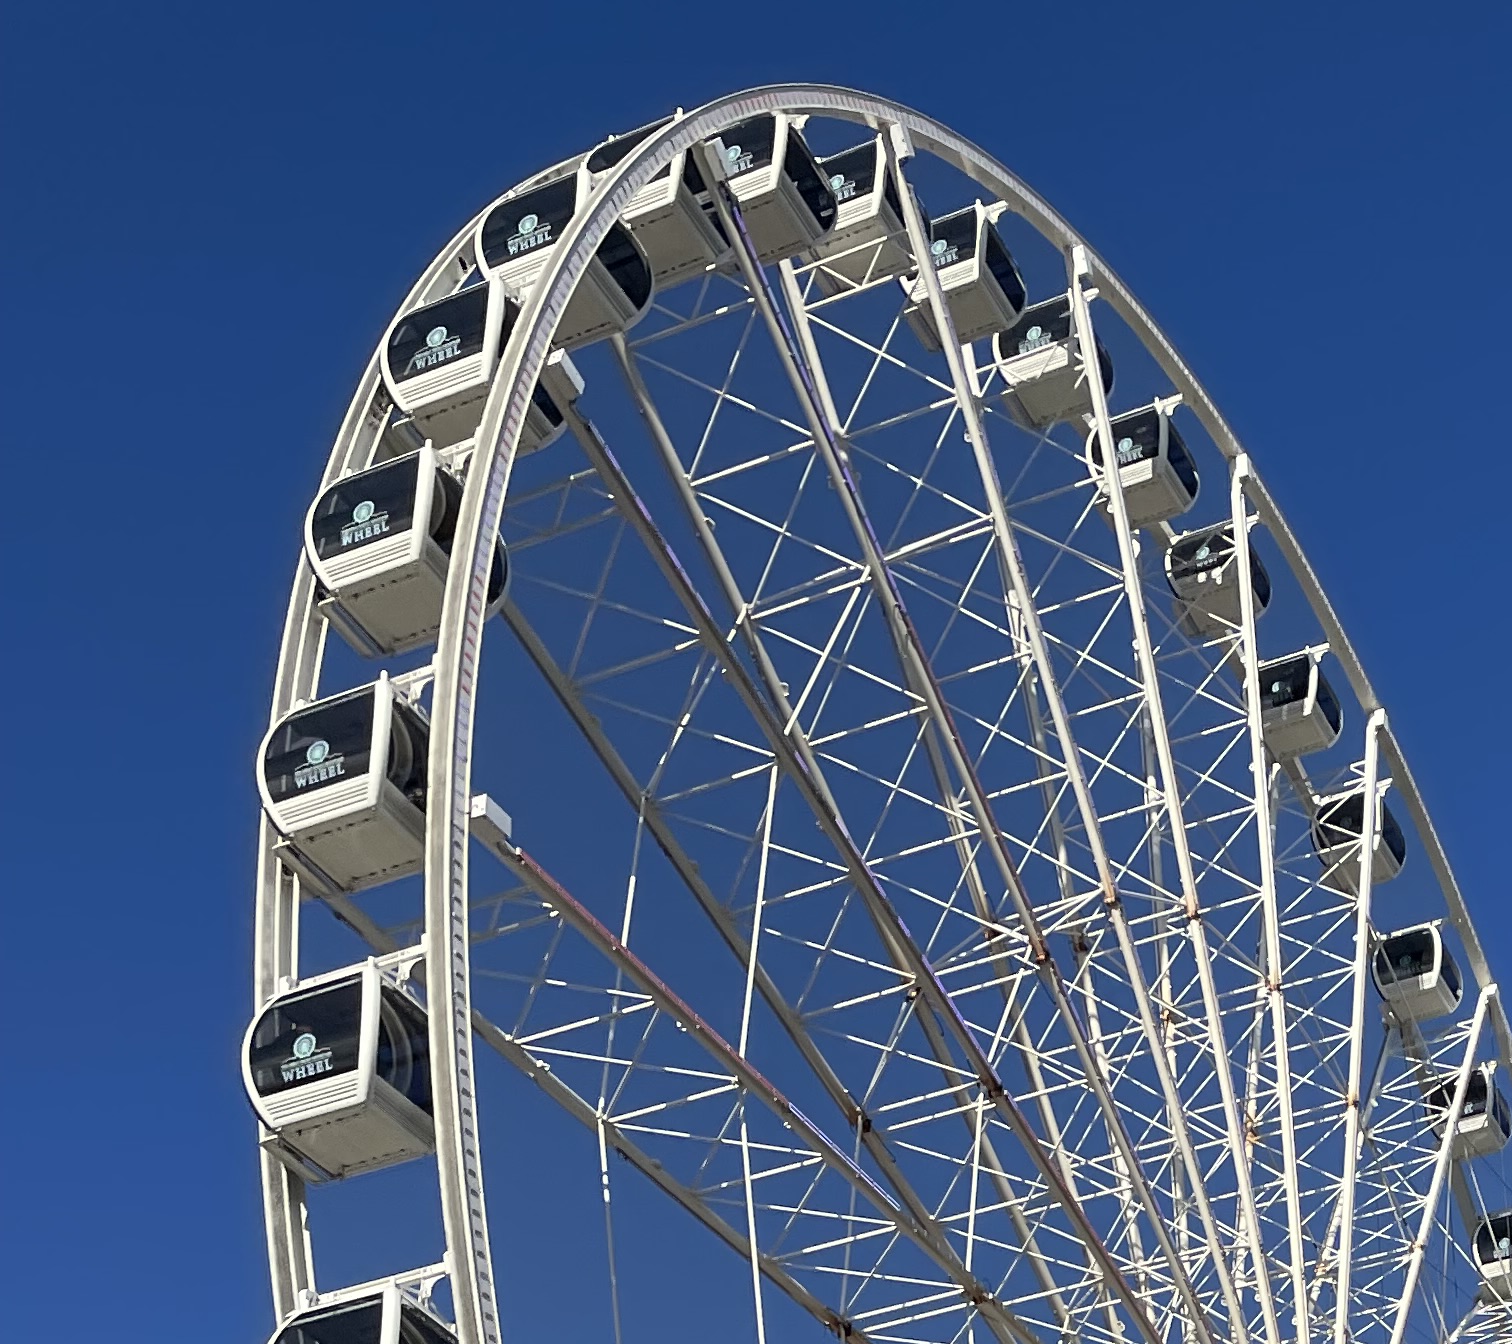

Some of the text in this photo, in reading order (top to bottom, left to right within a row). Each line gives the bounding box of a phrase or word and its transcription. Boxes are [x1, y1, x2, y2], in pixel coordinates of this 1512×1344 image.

[508, 231, 552, 255] WHEEL
[415, 343, 461, 370] WHEEL
[341, 520, 390, 546] WHEEL
[294, 762, 345, 788] WHEEL
[282, 1058, 334, 1083] WHEEL
